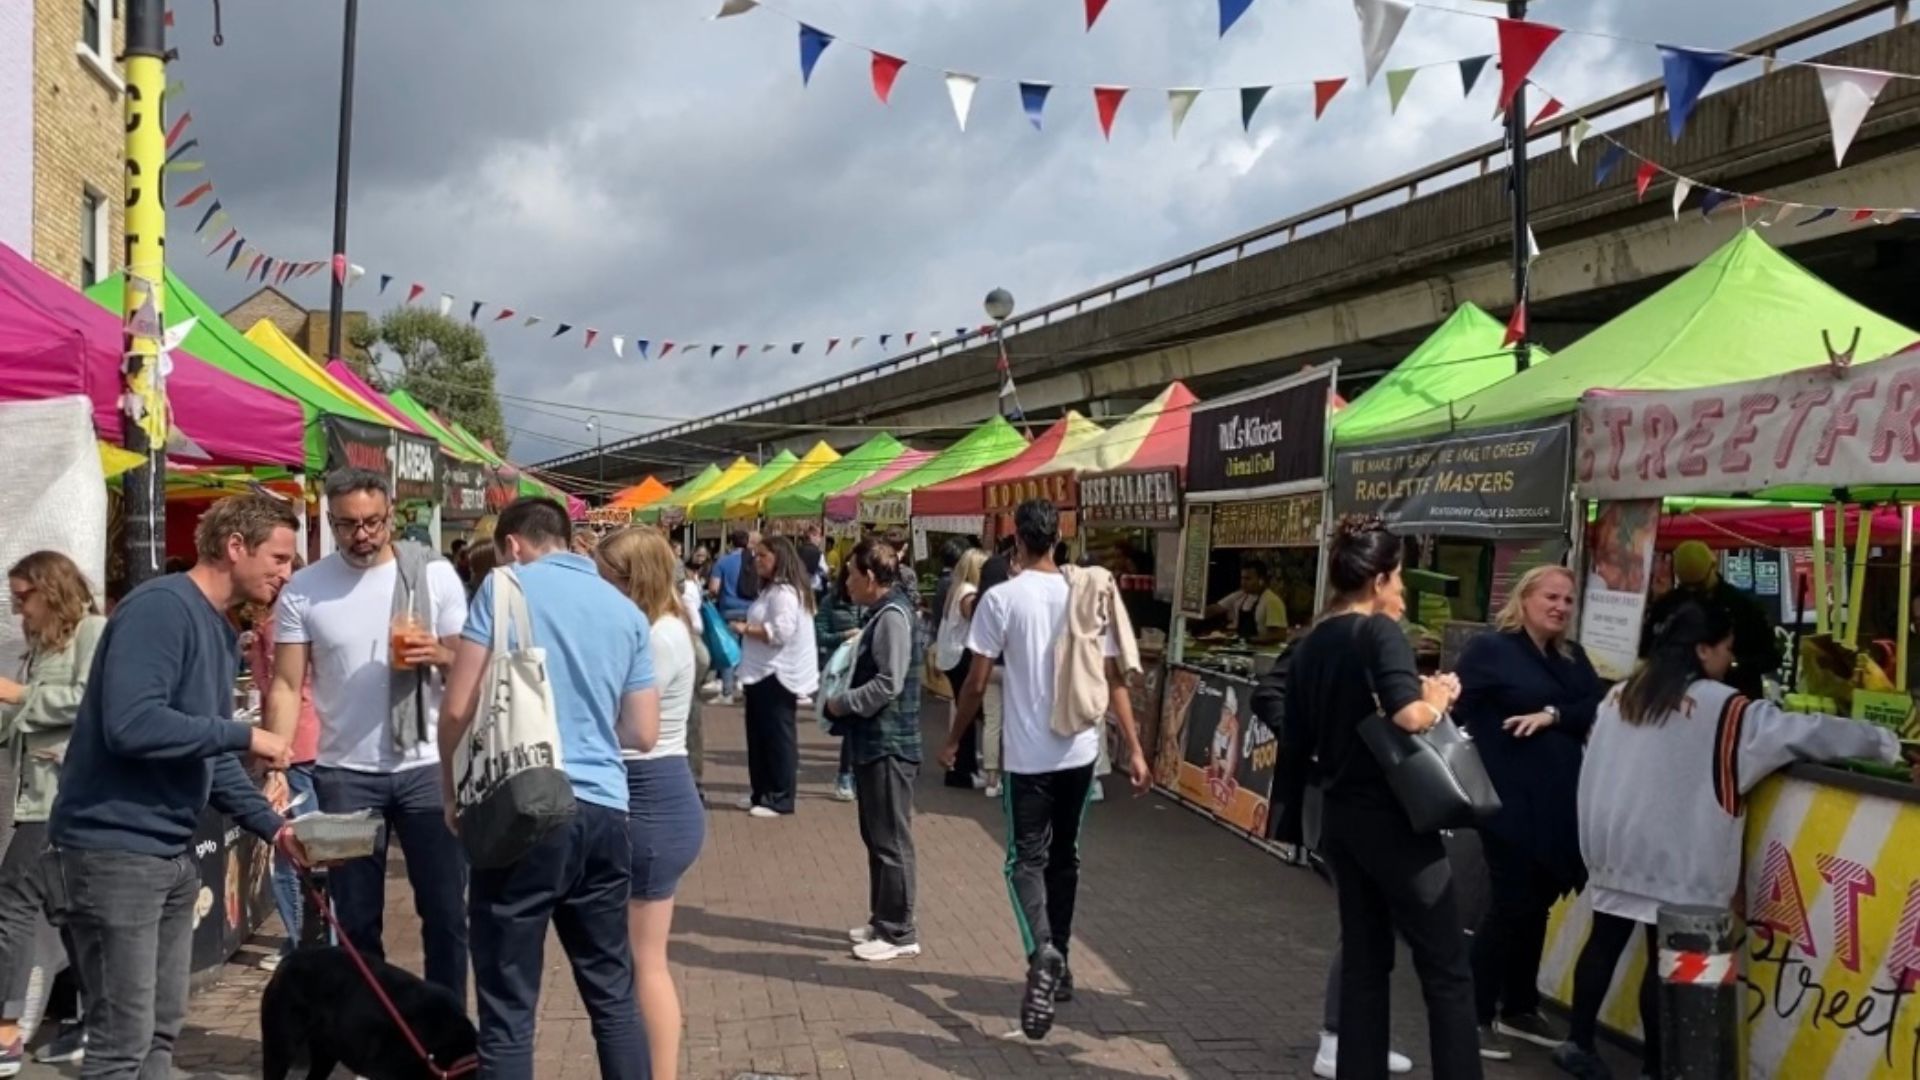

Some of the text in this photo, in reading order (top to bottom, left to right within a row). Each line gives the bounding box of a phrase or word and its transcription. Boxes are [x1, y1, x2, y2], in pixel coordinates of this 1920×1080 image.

[1366, 456, 1392, 473] MAKE
[1493, 440, 1538, 459] CHEESY
[1355, 470, 1514, 501] RACLETTE MASTERS
